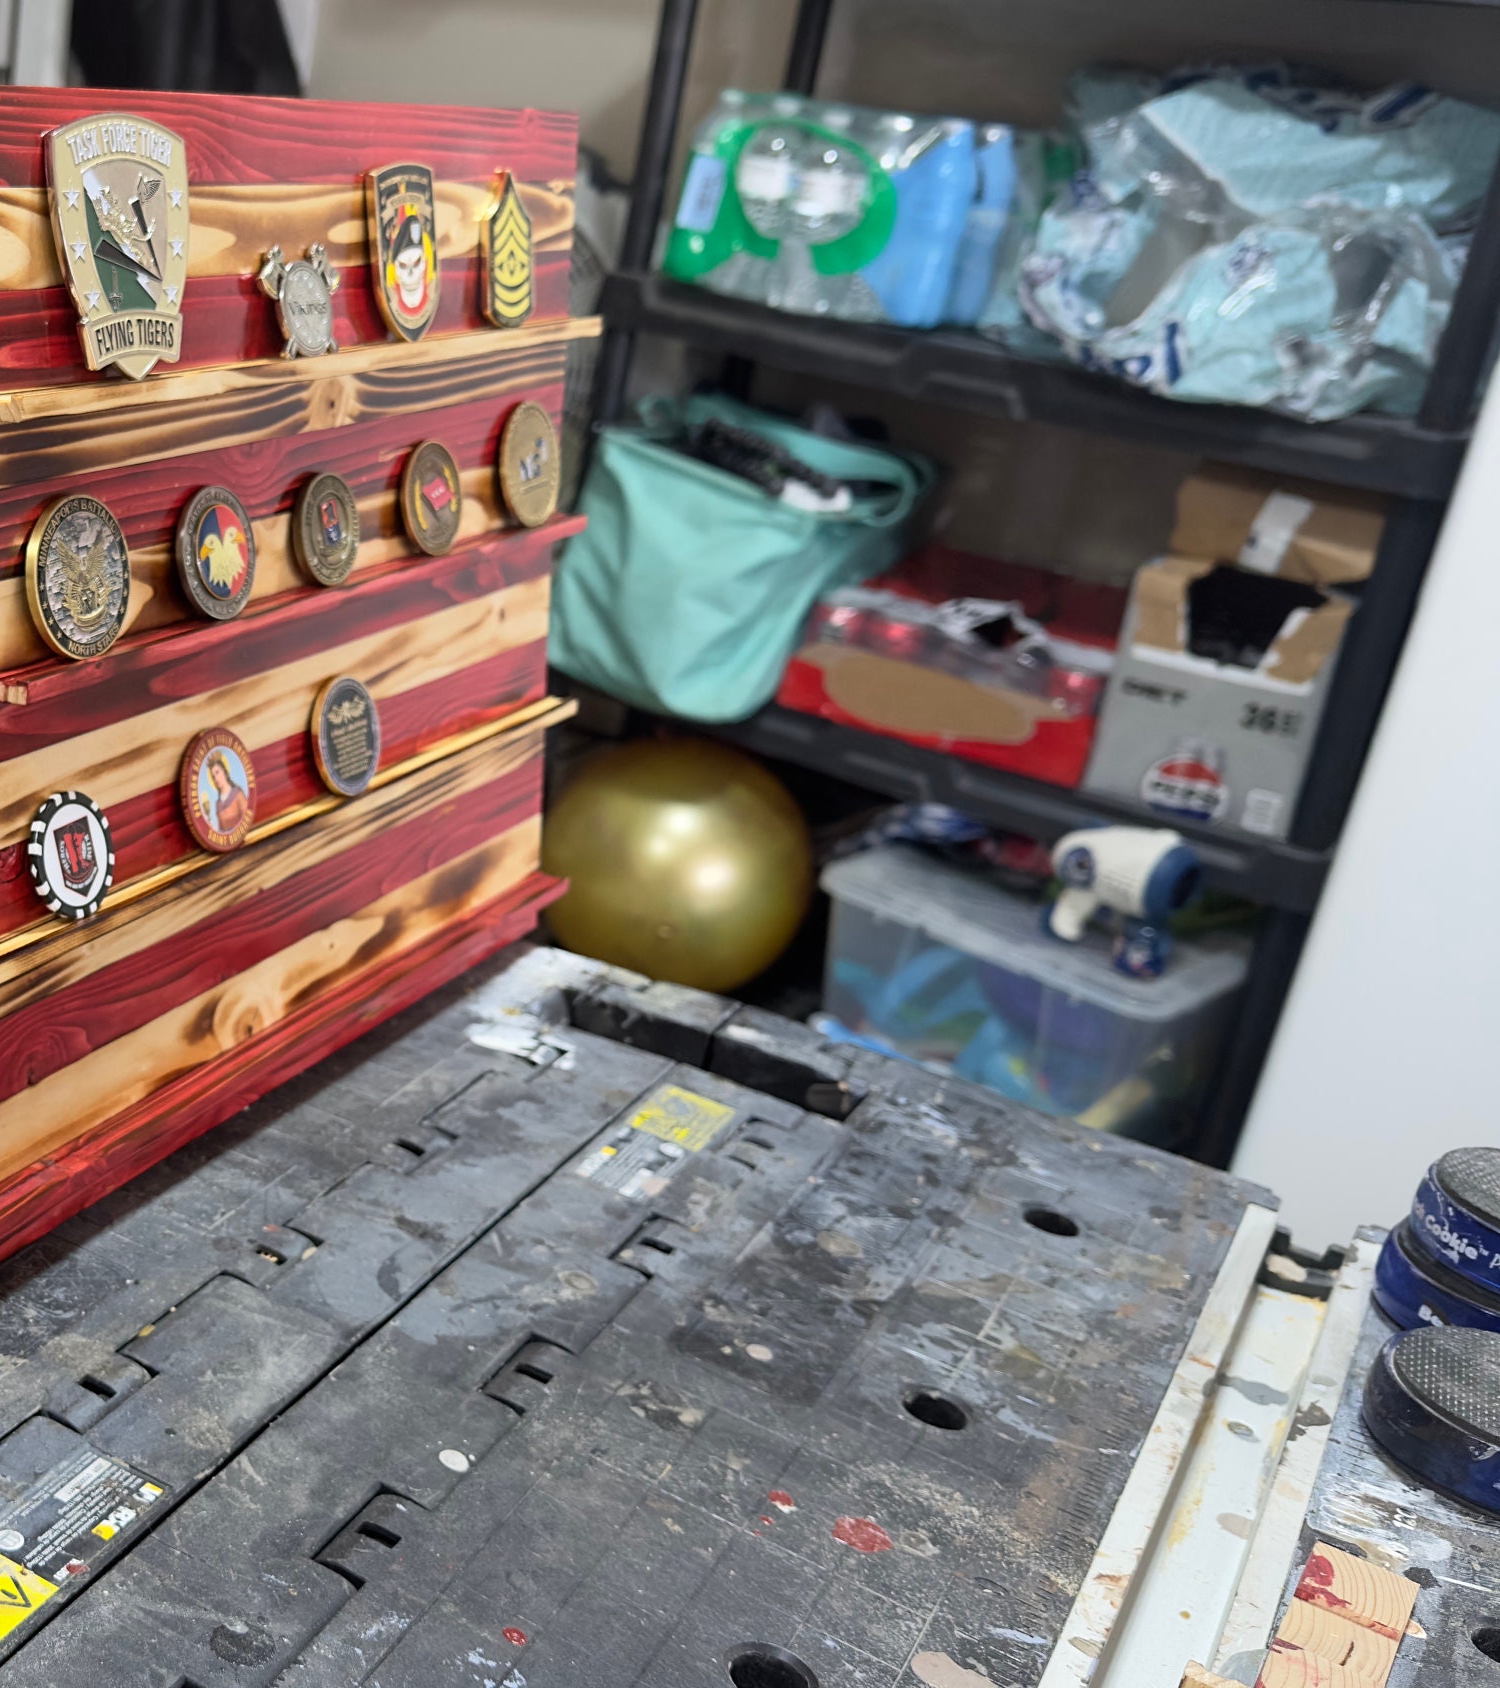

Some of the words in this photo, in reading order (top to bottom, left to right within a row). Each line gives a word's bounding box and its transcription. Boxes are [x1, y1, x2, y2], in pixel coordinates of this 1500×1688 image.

[66, 127, 101, 165] TASK
[102, 123, 138, 154] FORCE
[139, 127, 174, 168] TIGER
[95, 319, 135, 355] FLYING
[137, 319, 175, 349] TIGERS
[68, 640, 96, 656] NORTH
[97, 622, 120, 651] STARS
